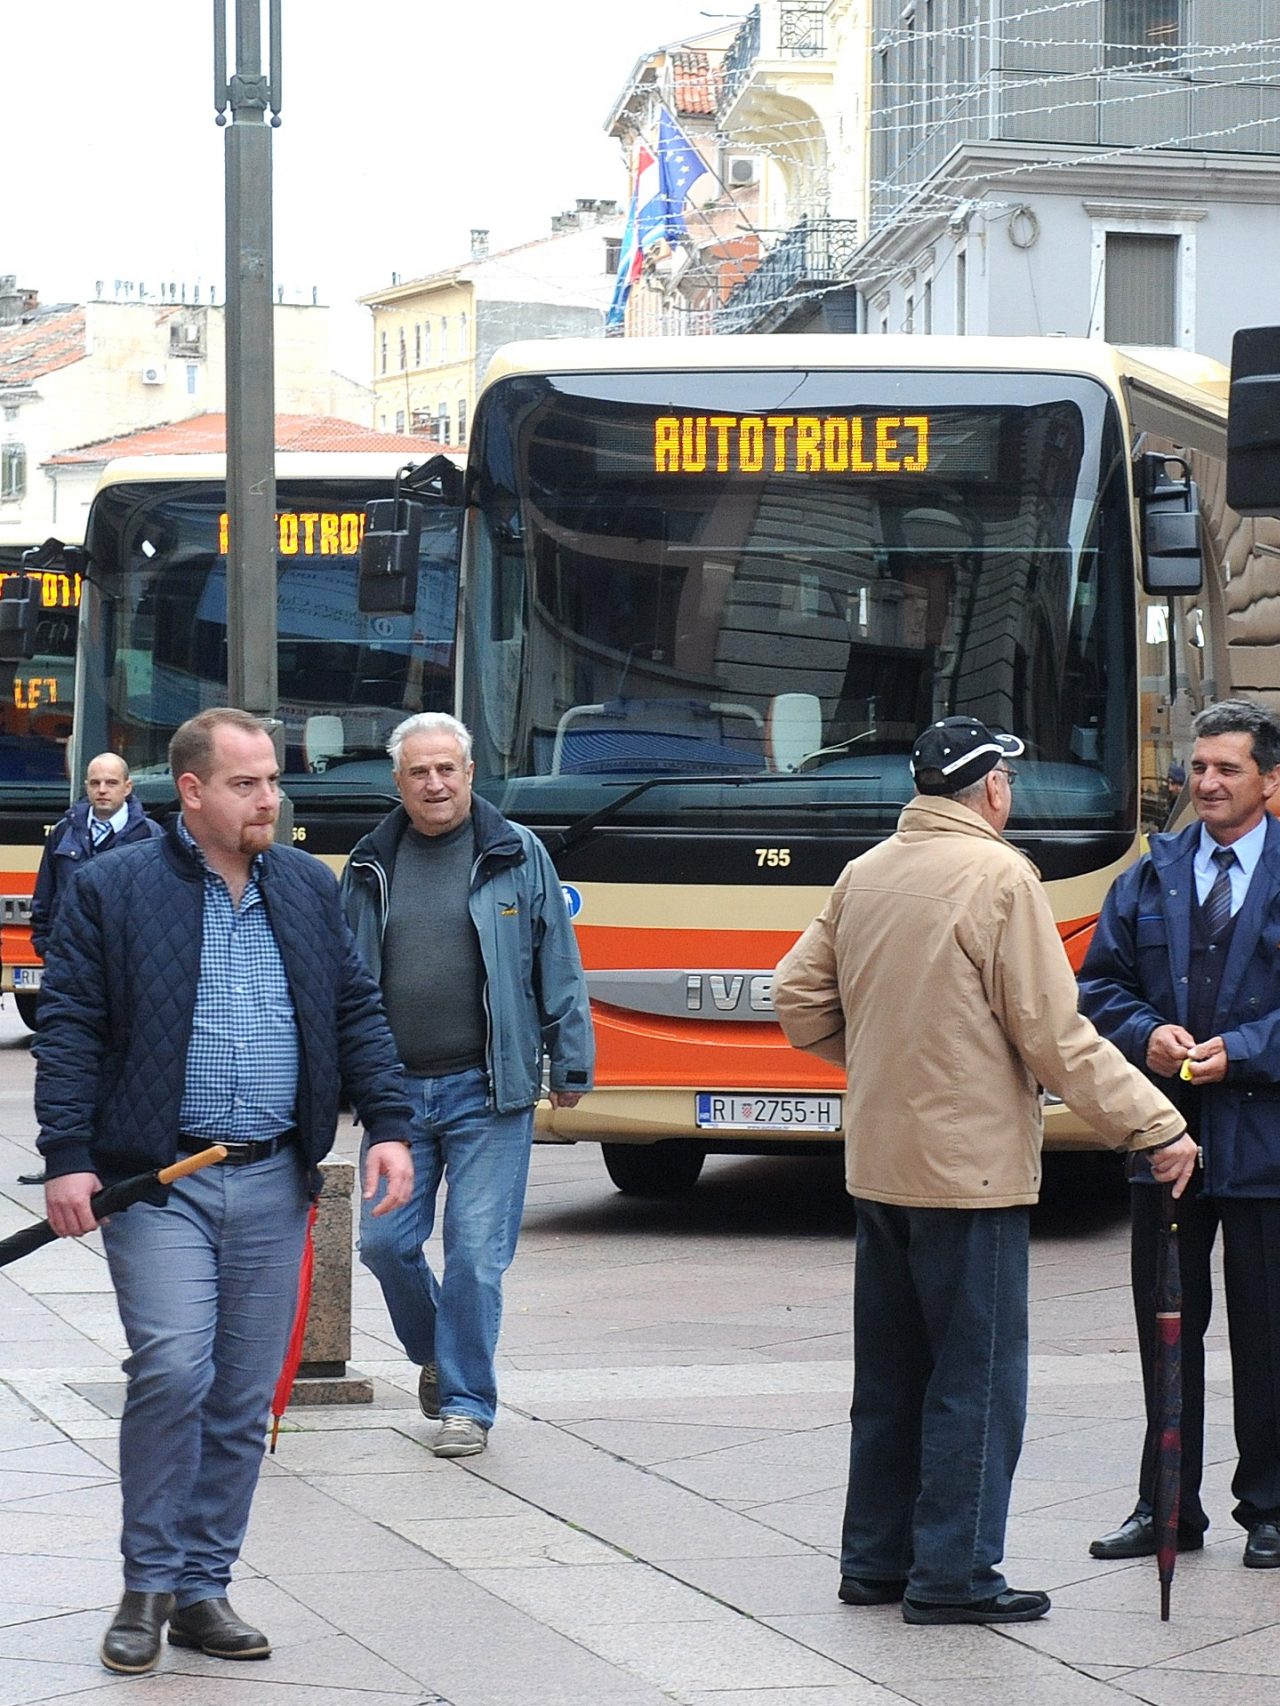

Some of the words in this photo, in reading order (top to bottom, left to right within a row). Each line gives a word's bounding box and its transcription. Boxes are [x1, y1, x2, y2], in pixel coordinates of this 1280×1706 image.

[654, 416, 929, 472] AUTOTROLEJ
[755, 848, 791, 867] 755
[713, 1099, 735, 1120] RI
[754, 1099, 831, 1123] 2755-H
